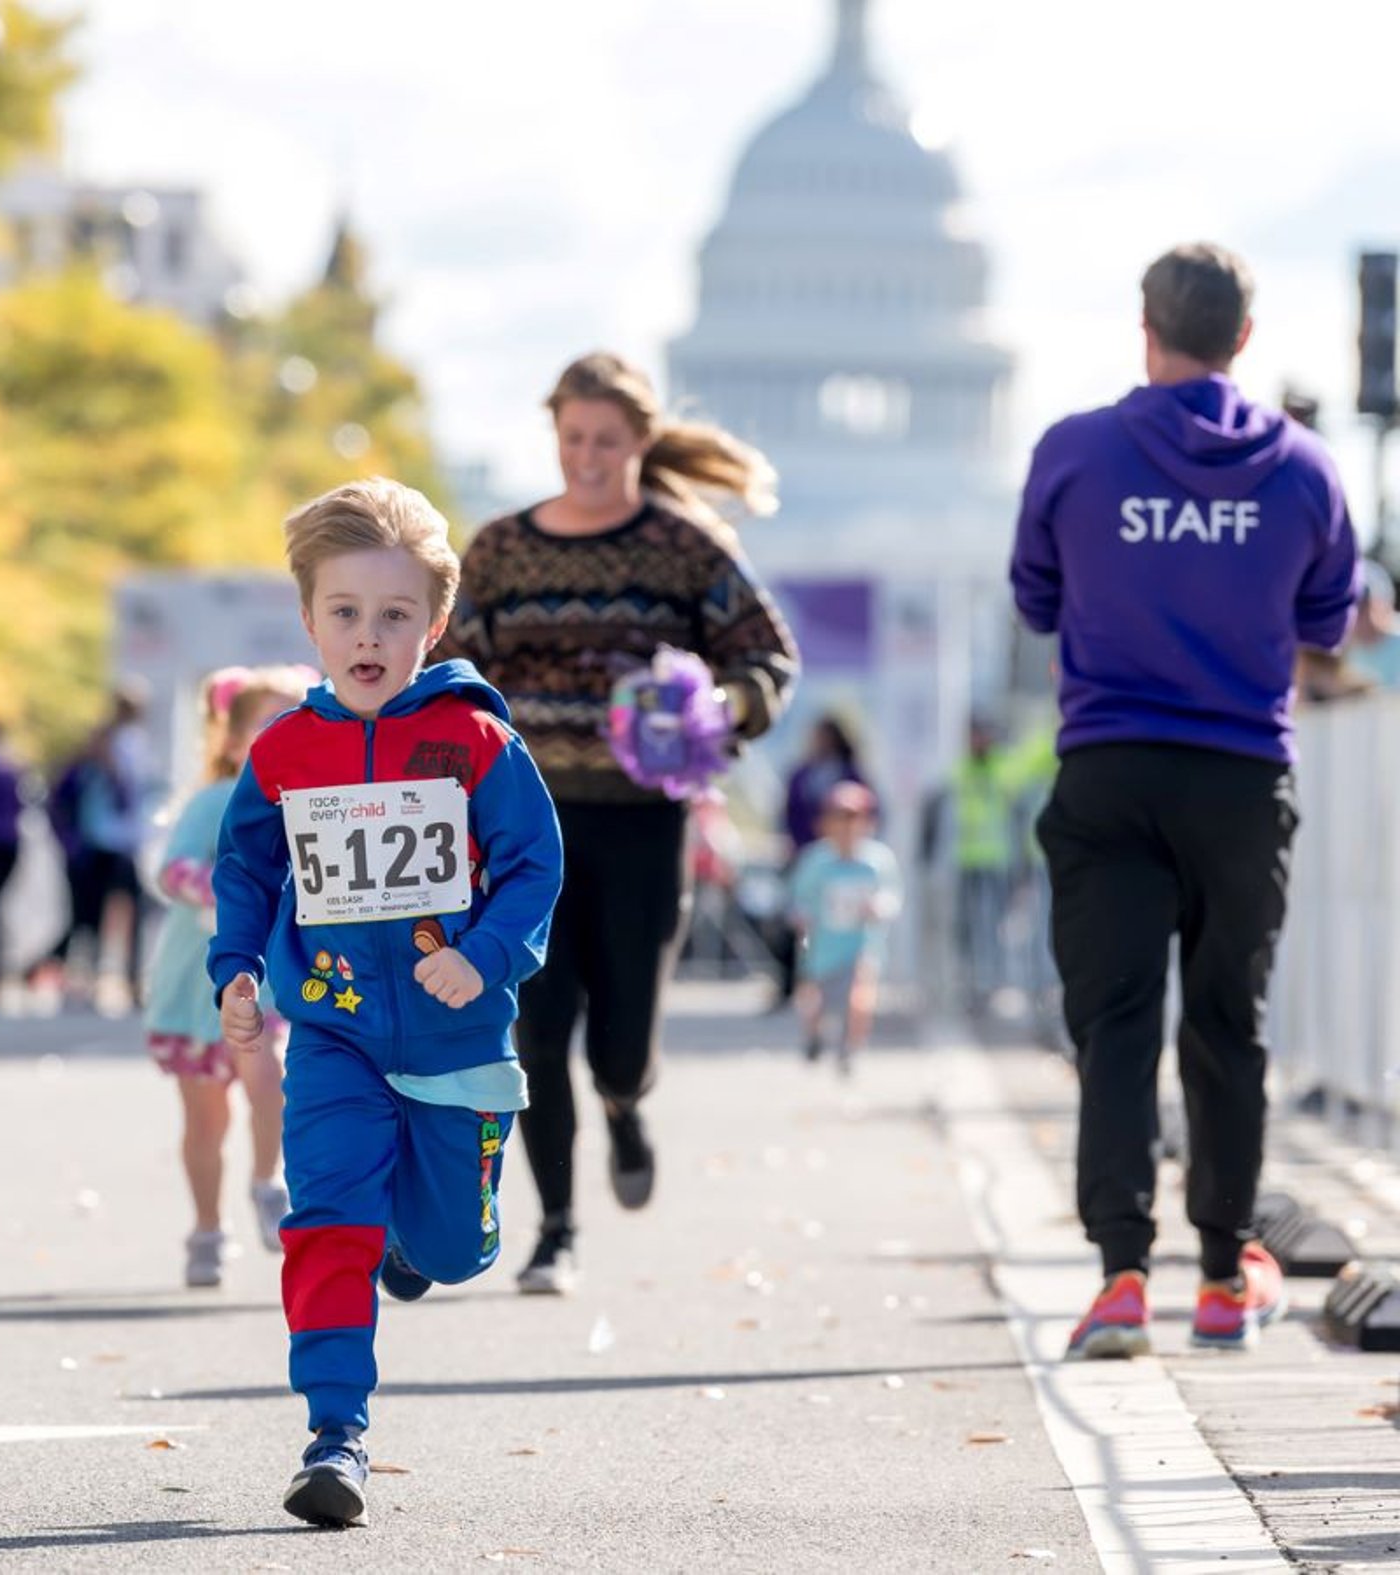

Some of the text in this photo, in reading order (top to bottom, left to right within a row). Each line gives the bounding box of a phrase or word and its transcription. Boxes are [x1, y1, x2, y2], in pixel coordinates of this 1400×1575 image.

[1119, 497, 1260, 544] STAFF
[309, 796, 340, 808] race
[310, 807, 348, 824] every
[350, 801, 386, 818] child
[295, 821, 458, 895] 5-123
